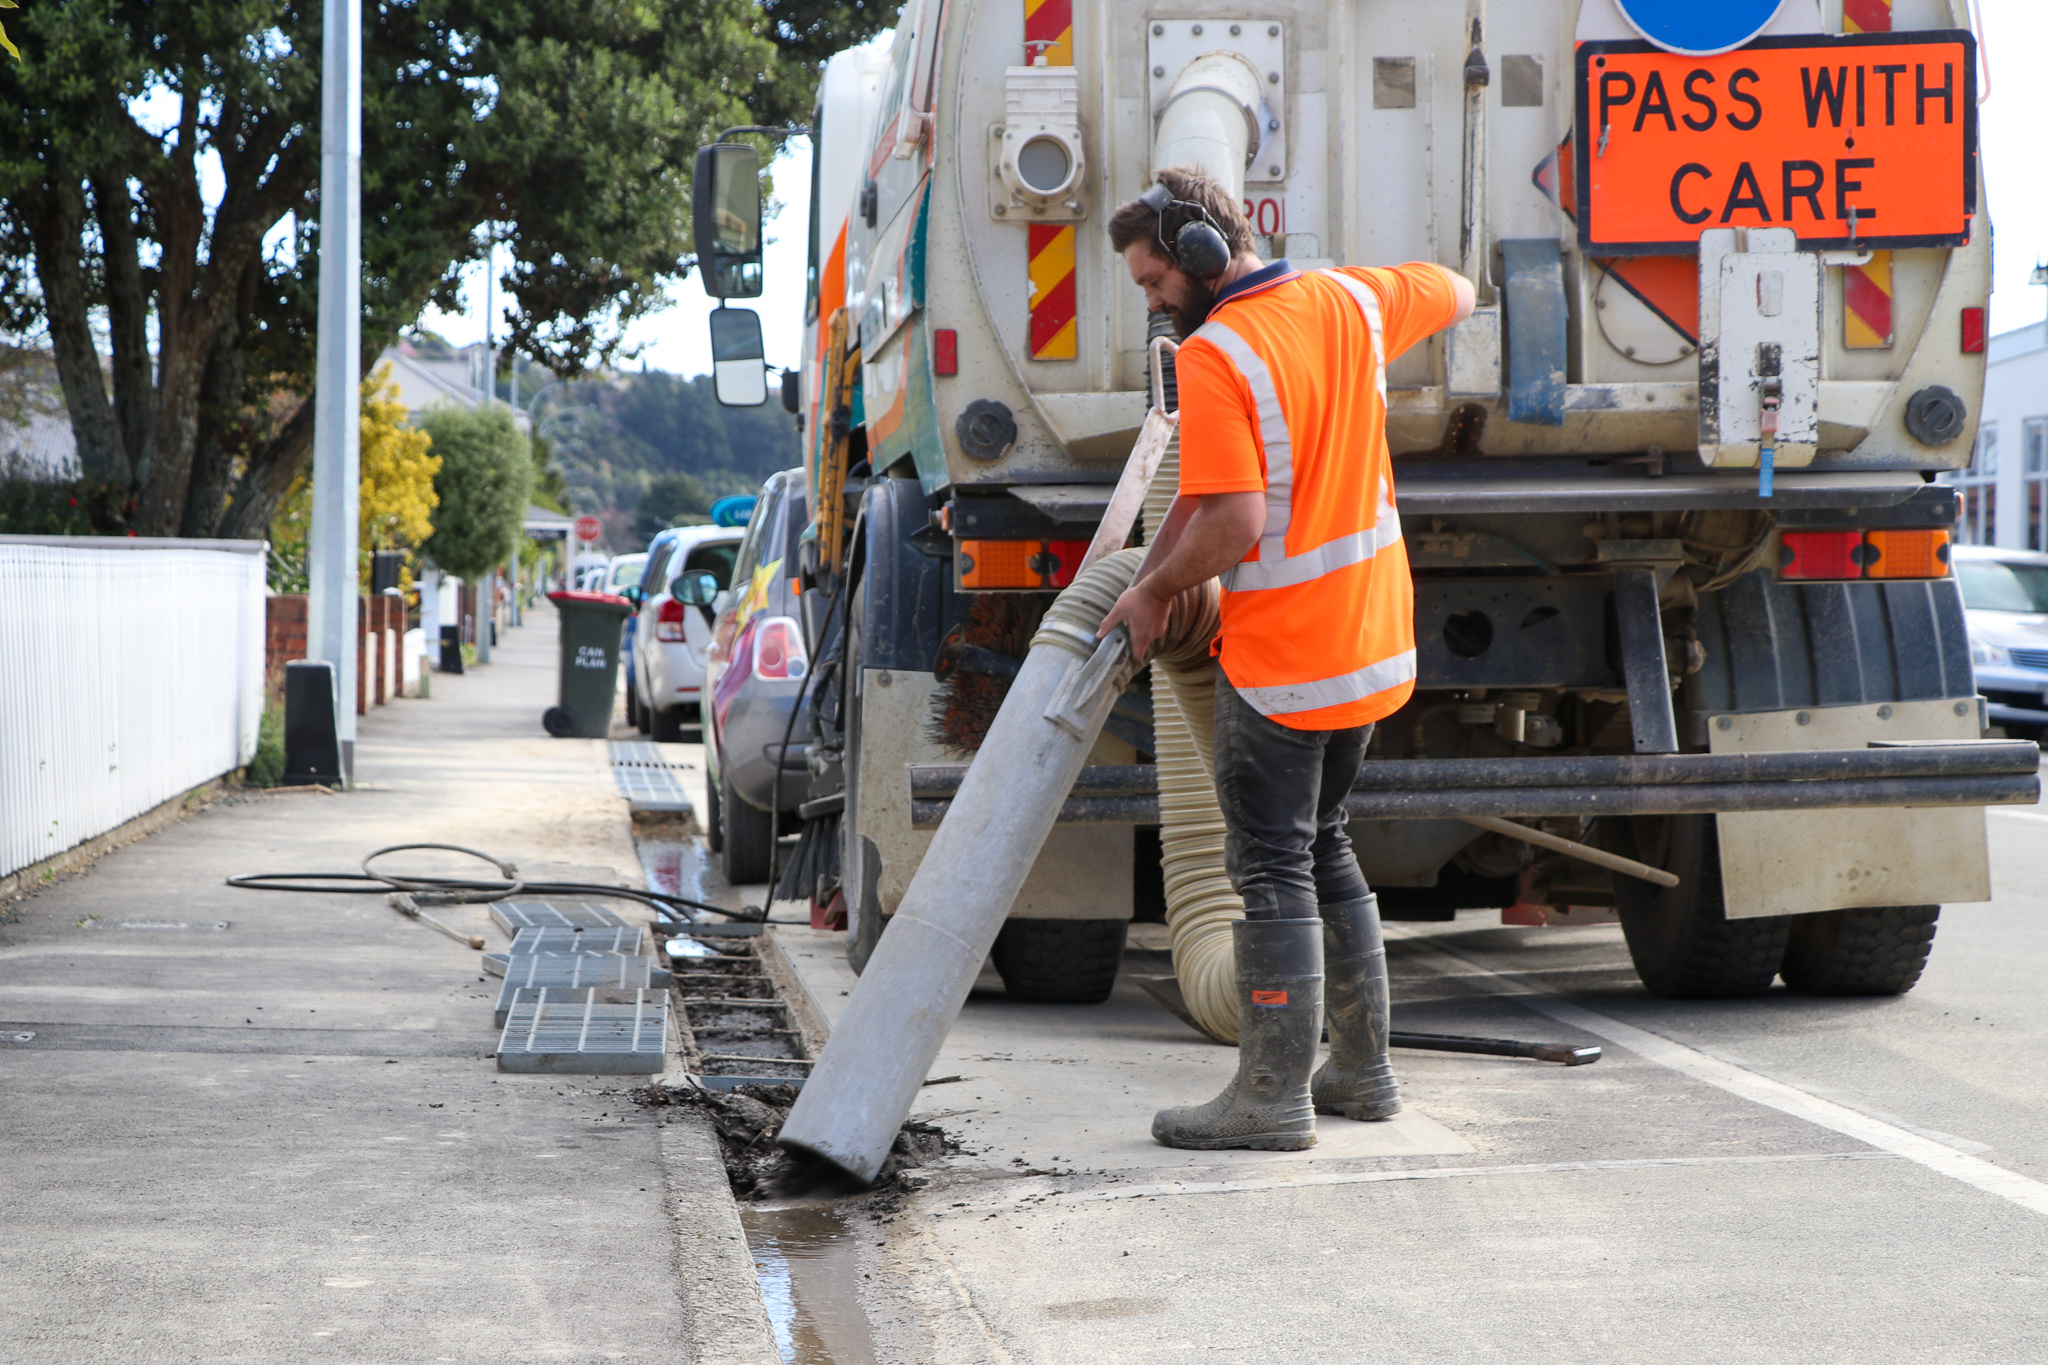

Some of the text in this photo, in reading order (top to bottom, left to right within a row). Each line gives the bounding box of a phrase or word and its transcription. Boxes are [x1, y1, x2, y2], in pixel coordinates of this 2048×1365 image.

[1600, 62, 1954, 132] PASS WITH
[1669, 157, 1876, 225] CARE
